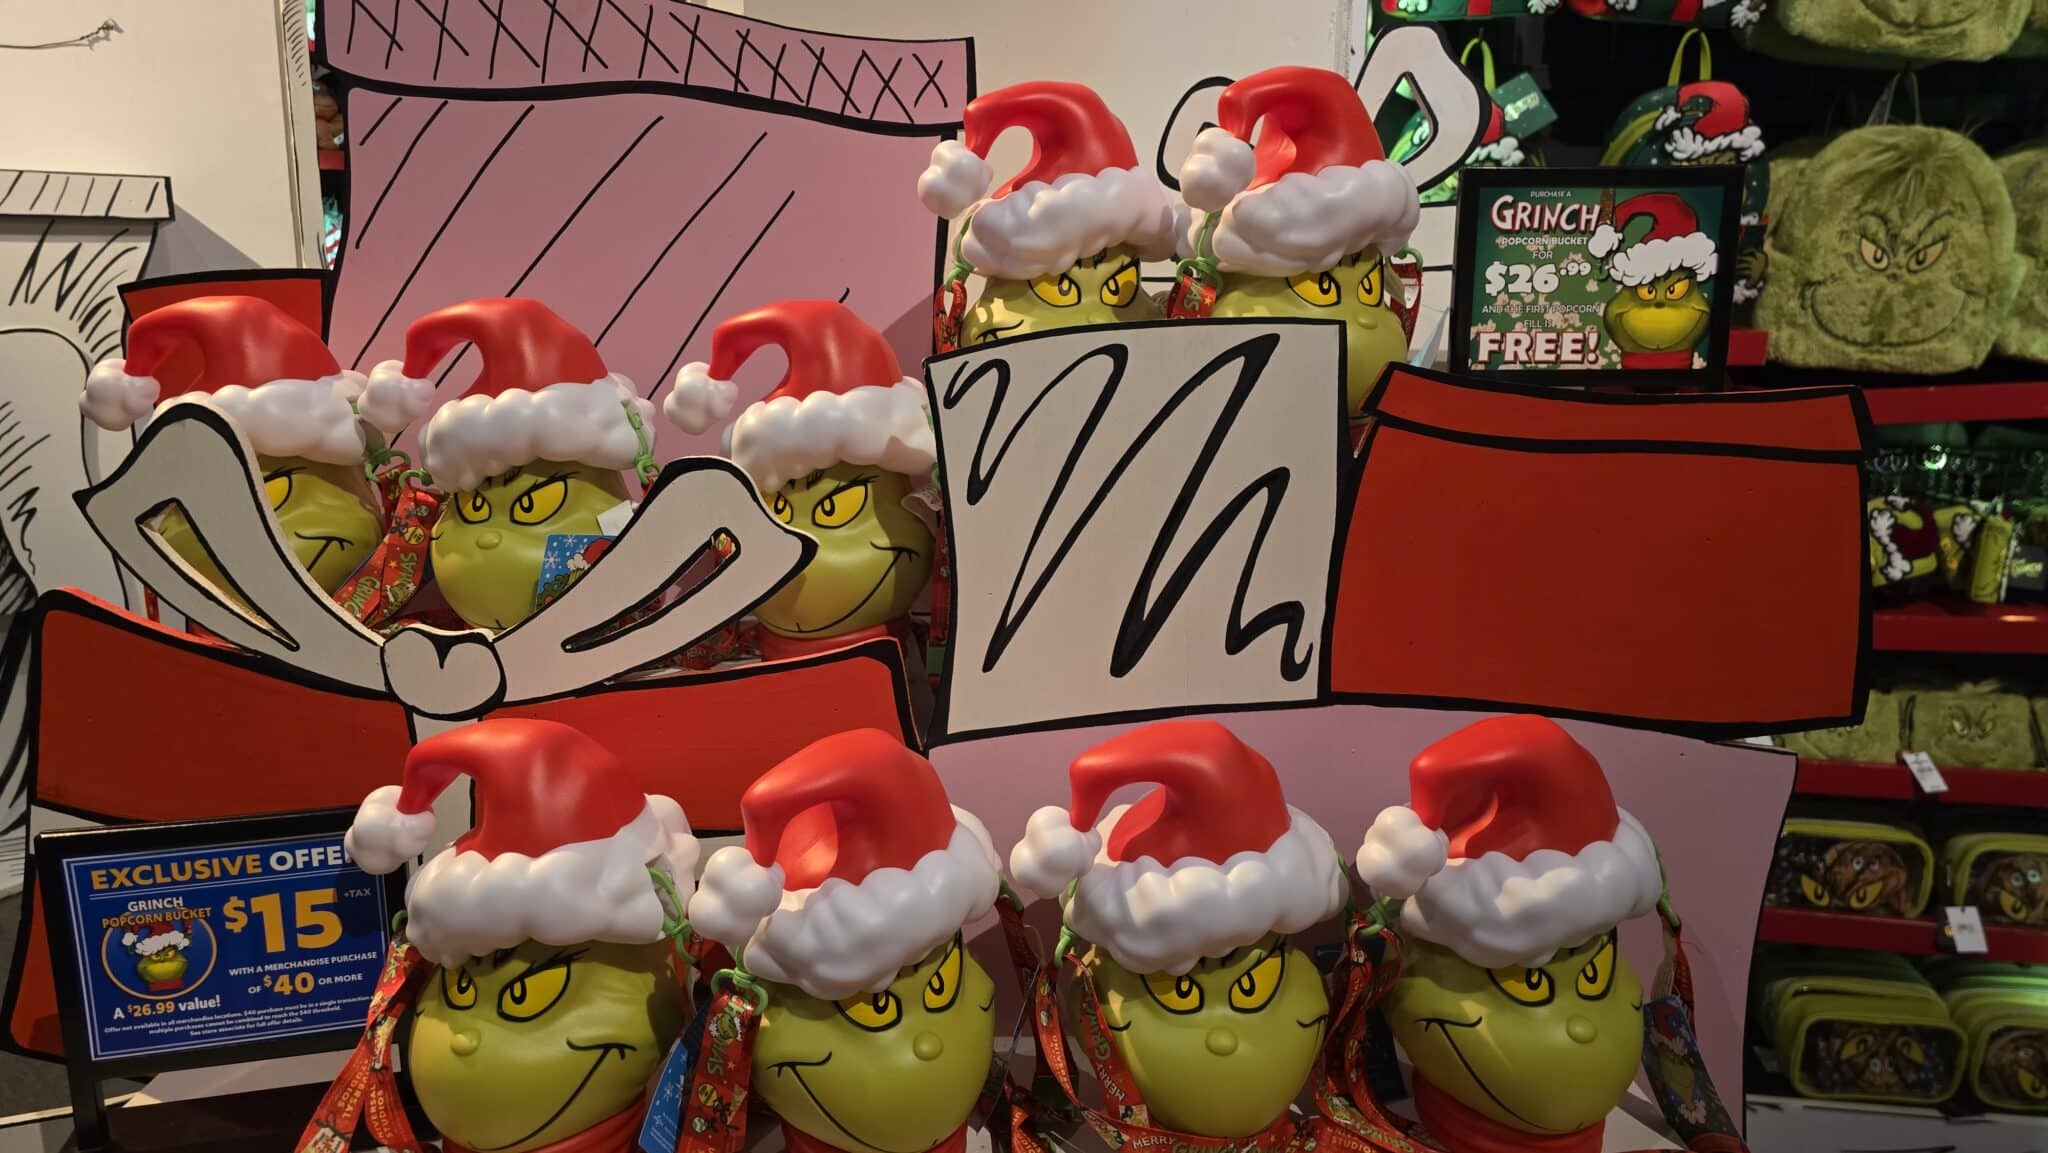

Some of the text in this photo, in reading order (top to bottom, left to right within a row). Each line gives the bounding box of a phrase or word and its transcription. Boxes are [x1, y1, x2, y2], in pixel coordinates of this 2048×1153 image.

[1491, 194, 1601, 232] GRINCH
[1502, 236, 1588, 245] POPCORN BUCKET
[1532, 250, 1553, 259] FOR
[1482, 304, 1503, 313] AND
[1526, 304, 1550, 313] FIRST
[1551, 304, 1600, 313] POPCORN
[1523, 319, 1543, 328] FILL
[1477, 331, 1599, 363] FREE!
[91, 854, 263, 890] EXCLUSIVE
[127, 897, 184, 912] GRINCH
[102, 907, 212, 928] POPCORN BUCKET
[223, 888, 343, 953] $15
[229, 952, 378, 976] WITH A MERCHANDISE PURCHASE
[248, 972, 363, 995] OF $40 OR MORE
[113, 994, 221, 1020] A $26.99 value!
[1131, 1134, 1178, 1150] MERRY
